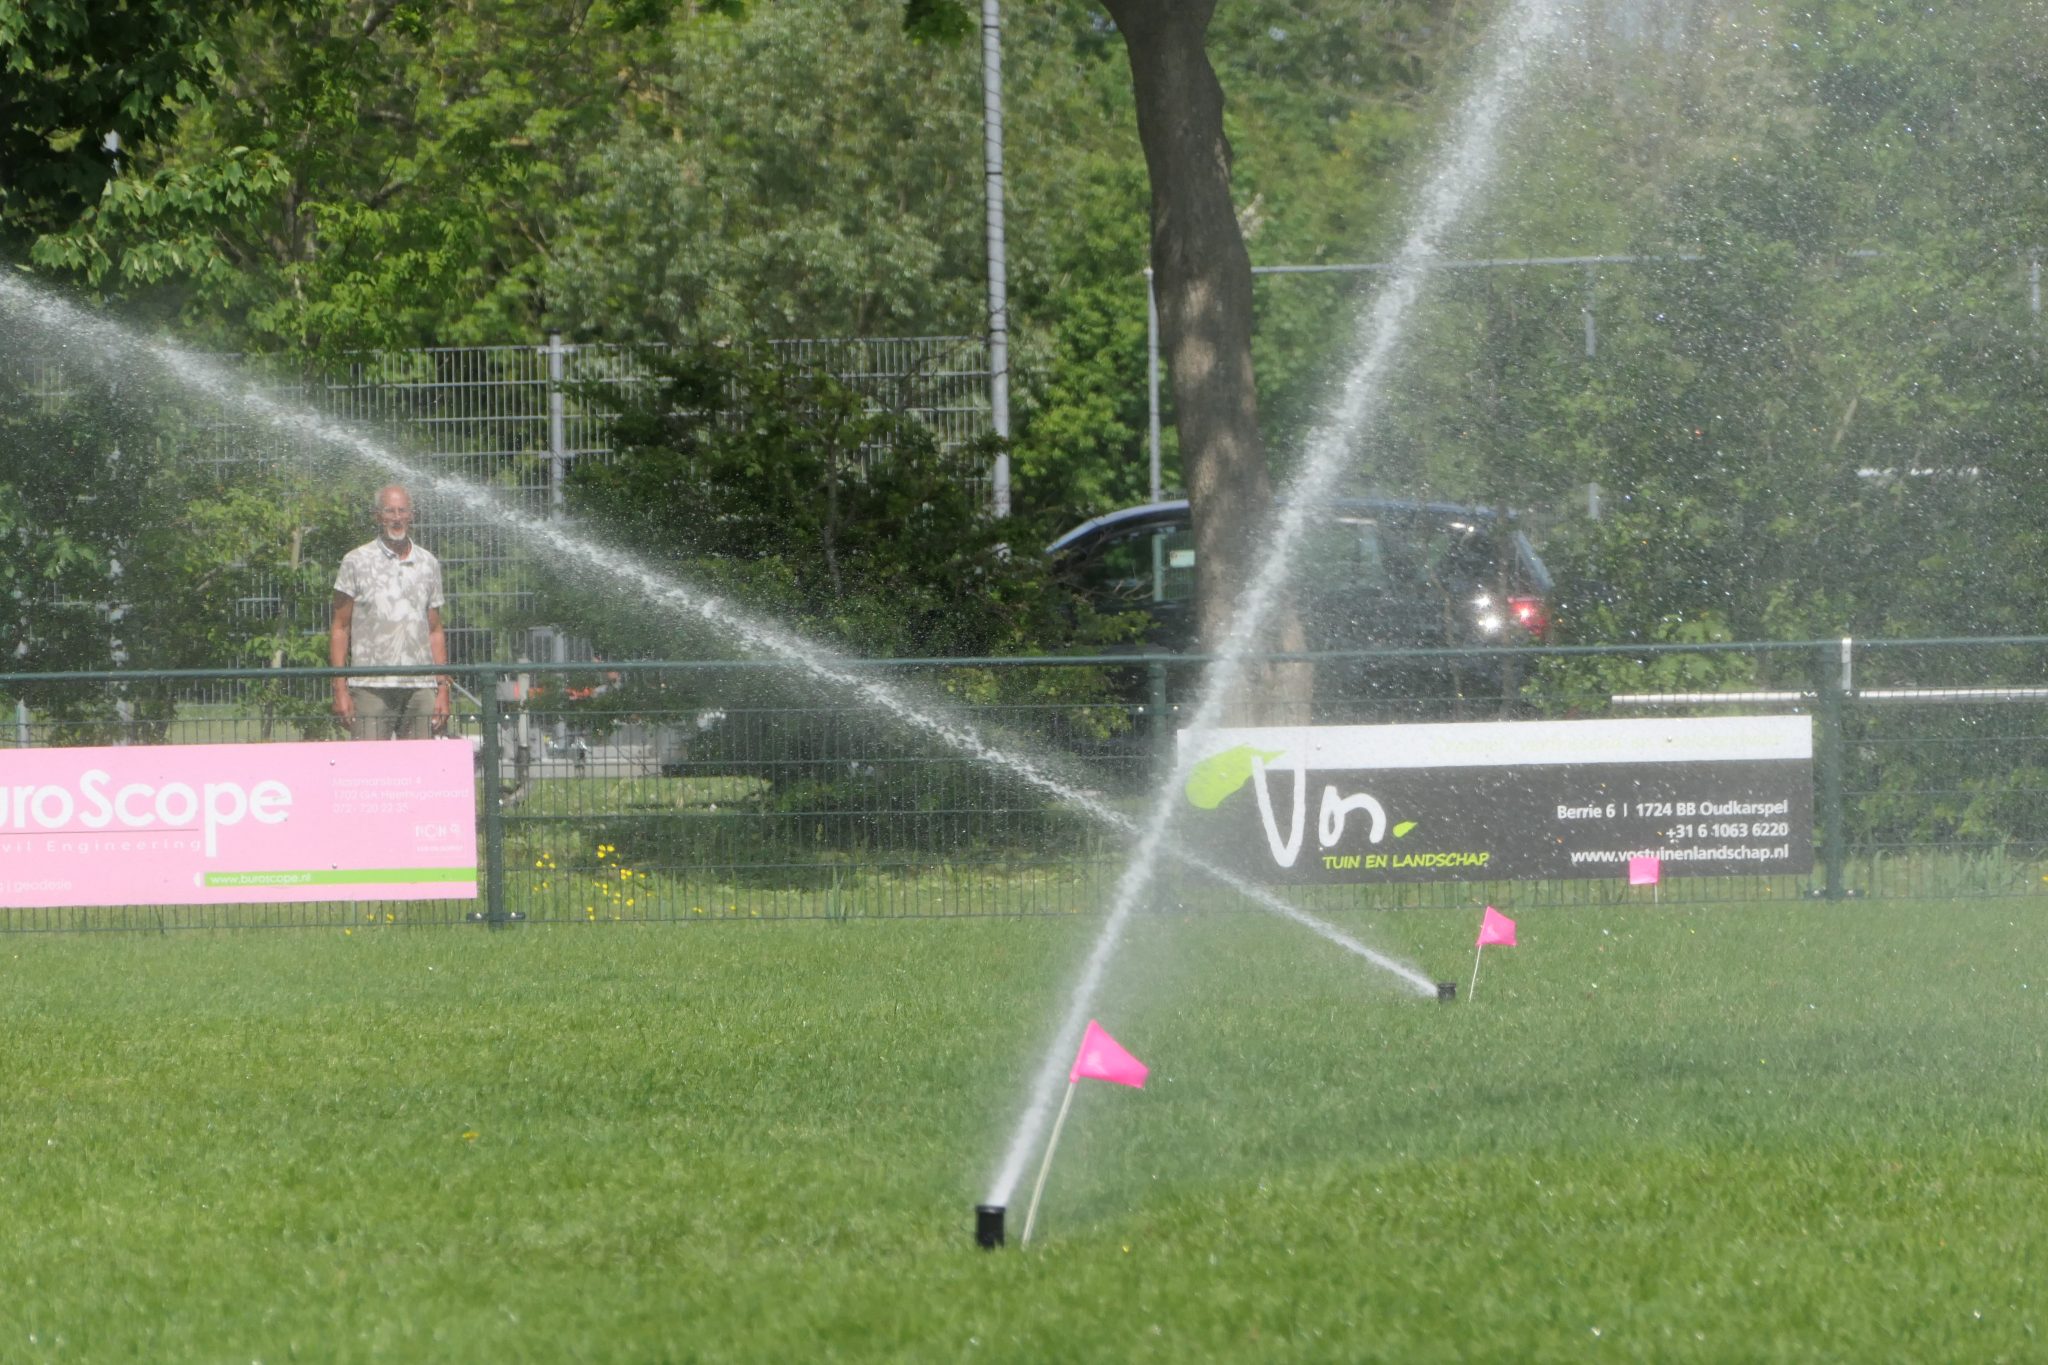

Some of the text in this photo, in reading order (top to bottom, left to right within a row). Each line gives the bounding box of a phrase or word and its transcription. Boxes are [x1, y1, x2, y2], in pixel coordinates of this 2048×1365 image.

[0, 769, 293, 858] roScope
[1557, 804, 1602, 819] Berrie
[1606, 804, 1616, 818] 6
[1636, 803, 1673, 817] 1724
[1676, 803, 1696, 816] BB
[1700, 800, 1789, 817] Oudkarspel
[1666, 822, 1789, 839] +31 6 1063 6220
[47, 839, 201, 854] Engineering
[1322, 852, 1491, 869] TUIN EN LANDSCHAP
